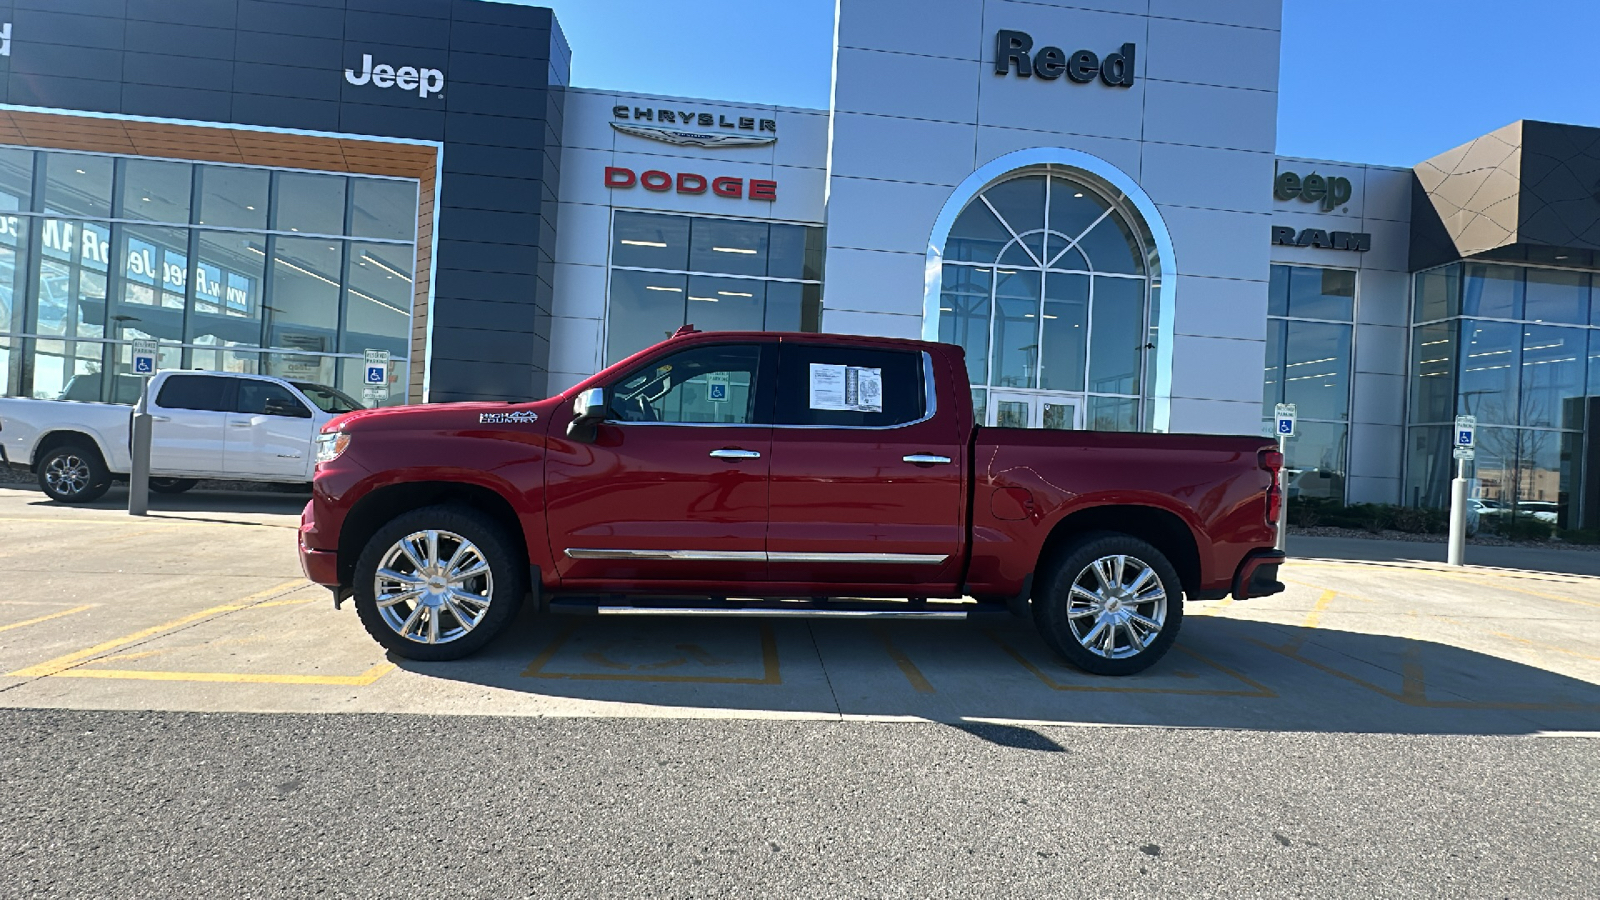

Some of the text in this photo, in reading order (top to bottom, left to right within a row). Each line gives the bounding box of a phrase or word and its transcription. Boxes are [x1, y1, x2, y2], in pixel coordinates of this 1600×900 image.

[344, 53, 444, 99] Jeep
[995, 29, 1136, 88] Reed
[612, 105, 777, 132] CHRYSLER
[604, 166, 778, 202] DODGE
[1275, 171, 1352, 213] eep
[1271, 225, 1371, 252] RAM
